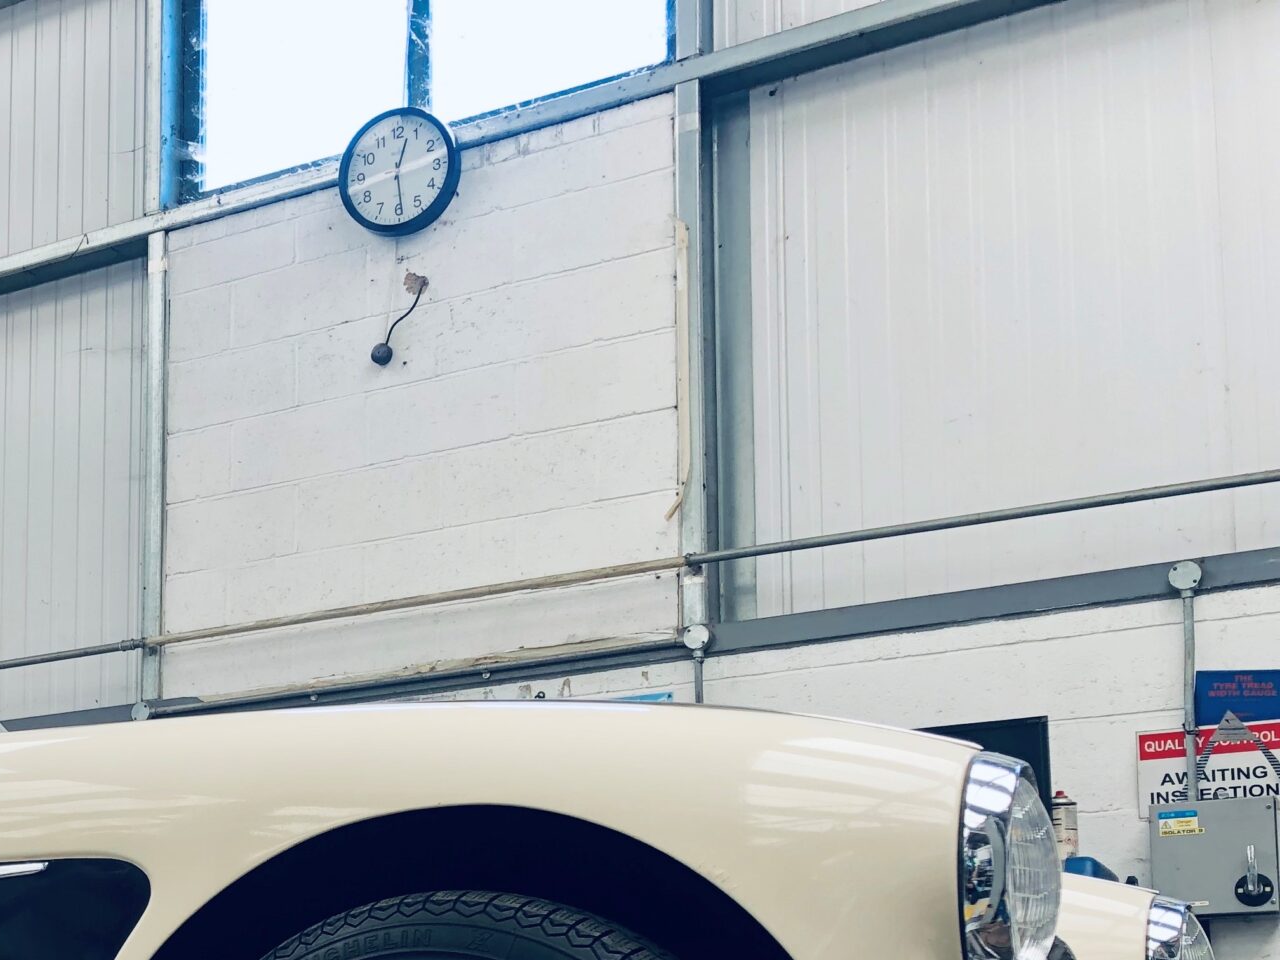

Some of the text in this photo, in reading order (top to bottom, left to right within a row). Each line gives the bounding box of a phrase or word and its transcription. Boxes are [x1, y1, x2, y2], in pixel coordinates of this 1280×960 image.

[391, 126, 404, 139] 12
[413, 128, 419, 140] 1
[375, 137, 386, 149] 11
[426, 139, 435, 152] 2
[362, 152, 375, 166] 10
[432, 158, 441, 171] 3
[357, 172, 366, 185] 9
[427, 177, 436, 190] 4
[363, 190, 372, 203] 8
[413, 195, 422, 208] 5
[376, 202, 385, 215] 7
[394, 203, 403, 216] 6
[1145, 737, 1206, 753] QUALIY
